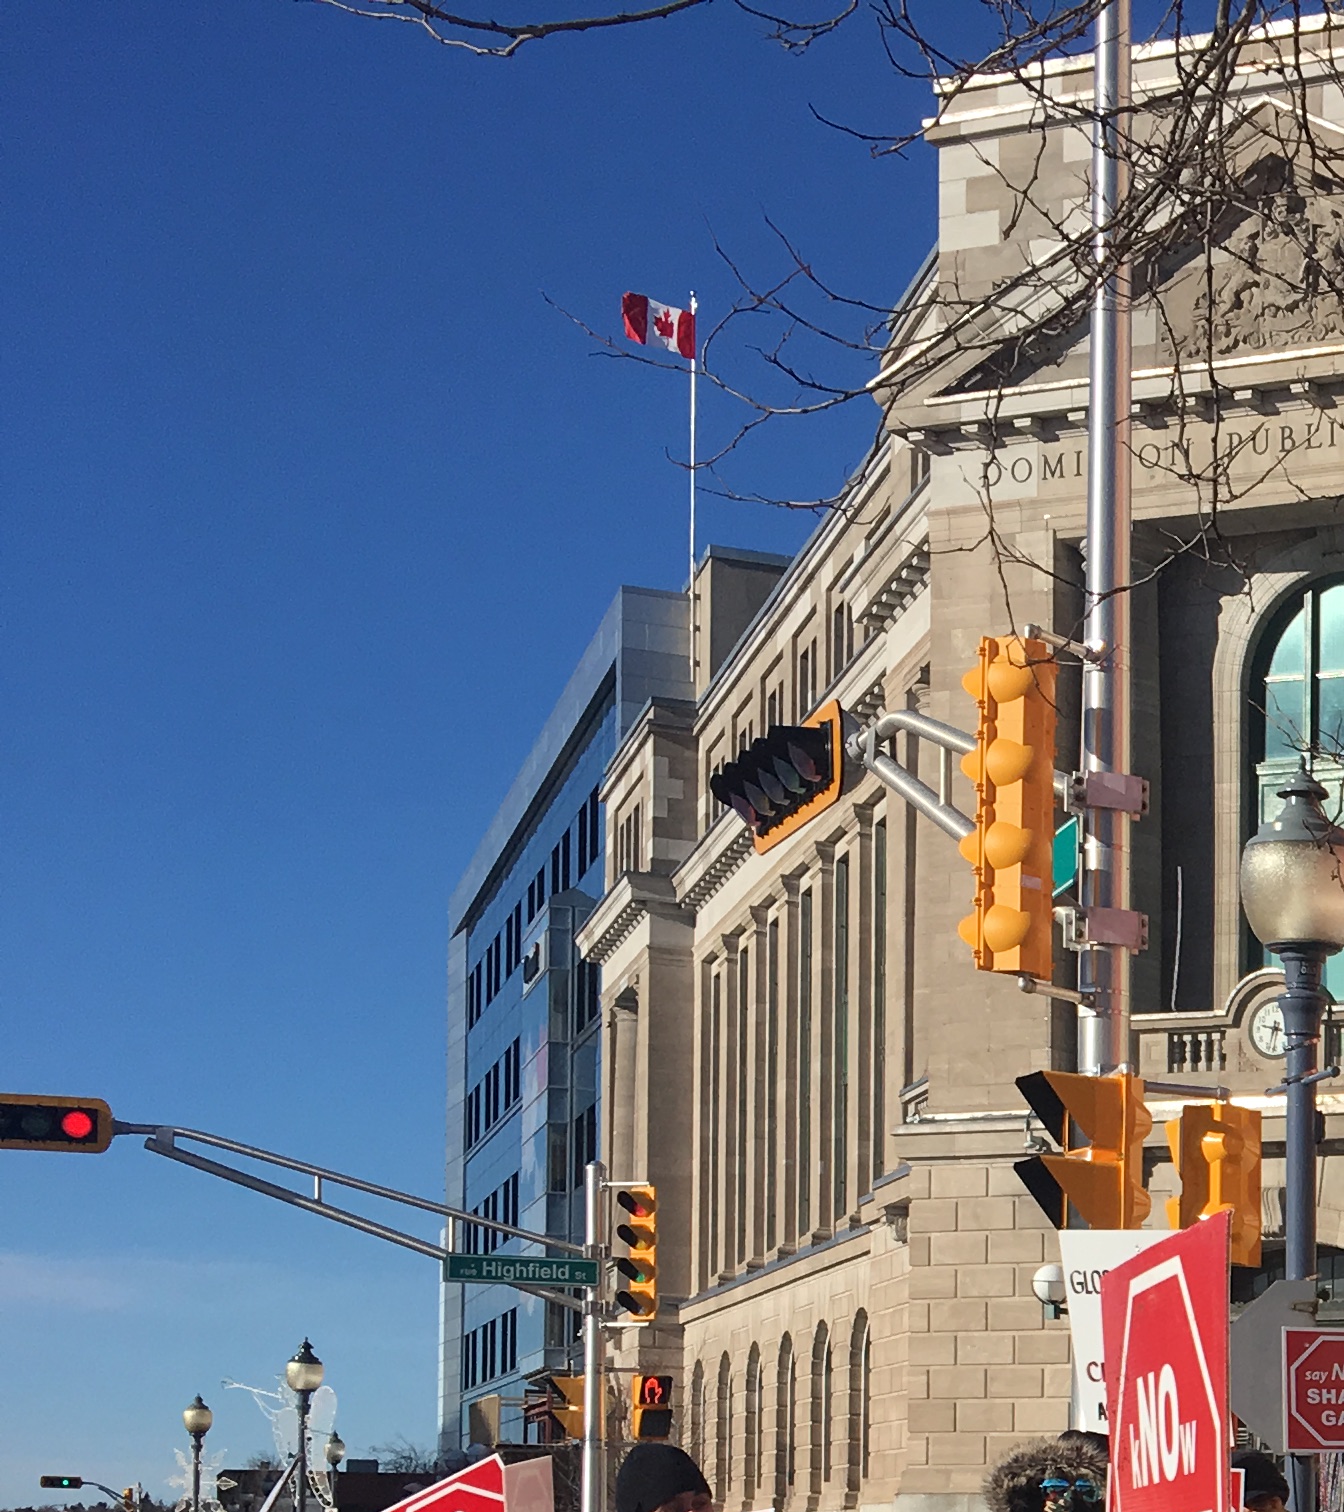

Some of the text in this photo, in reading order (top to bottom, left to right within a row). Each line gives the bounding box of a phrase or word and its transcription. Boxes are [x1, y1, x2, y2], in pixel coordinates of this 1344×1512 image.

[982, 437, 1195, 488] DOMION
[482, 1261, 569, 1281] Highfield
[574, 1271, 587, 1280] St
[1305, 1370, 1328, 1383] say
[1129, 1363, 1197, 1489] kNOw
